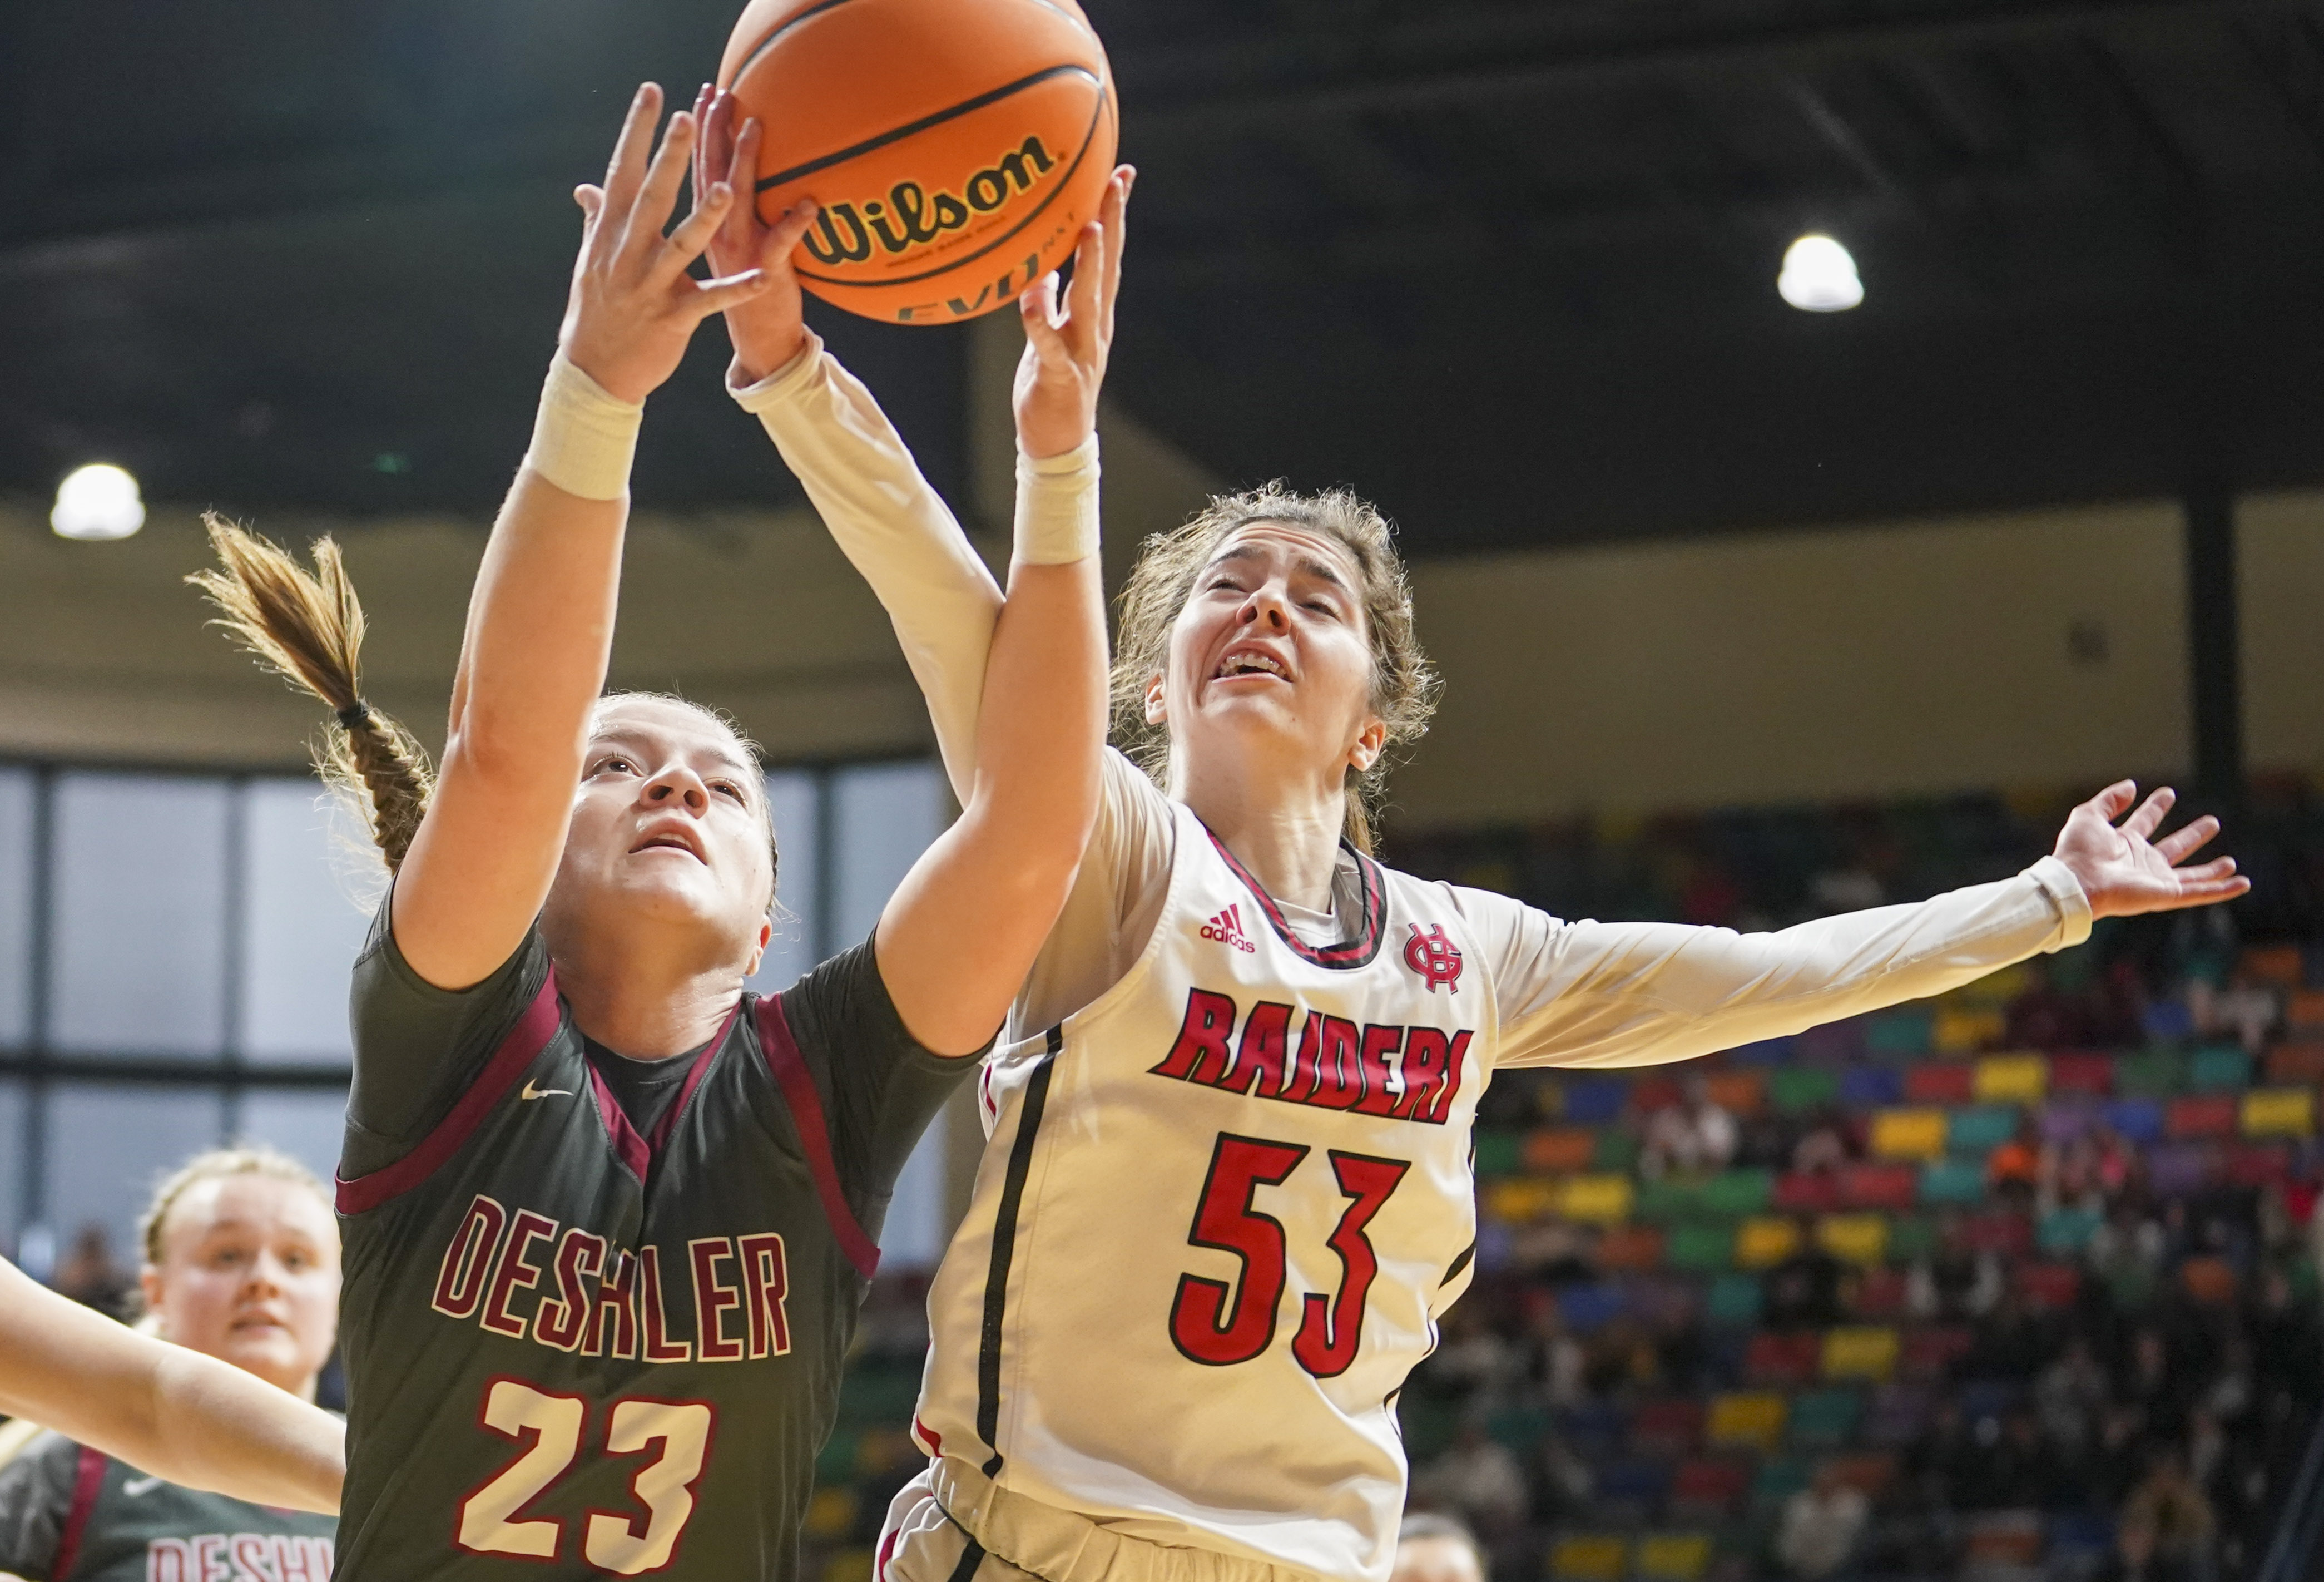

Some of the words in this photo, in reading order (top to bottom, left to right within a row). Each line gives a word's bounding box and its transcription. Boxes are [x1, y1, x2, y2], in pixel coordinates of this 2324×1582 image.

[783, 136, 1056, 265] Wilson
[1200, 925, 1256, 953] adidas
[431, 1193, 791, 1363] DESHLER
[1168, 1131, 1412, 1379] 53
[456, 1376, 715, 1578] 23
